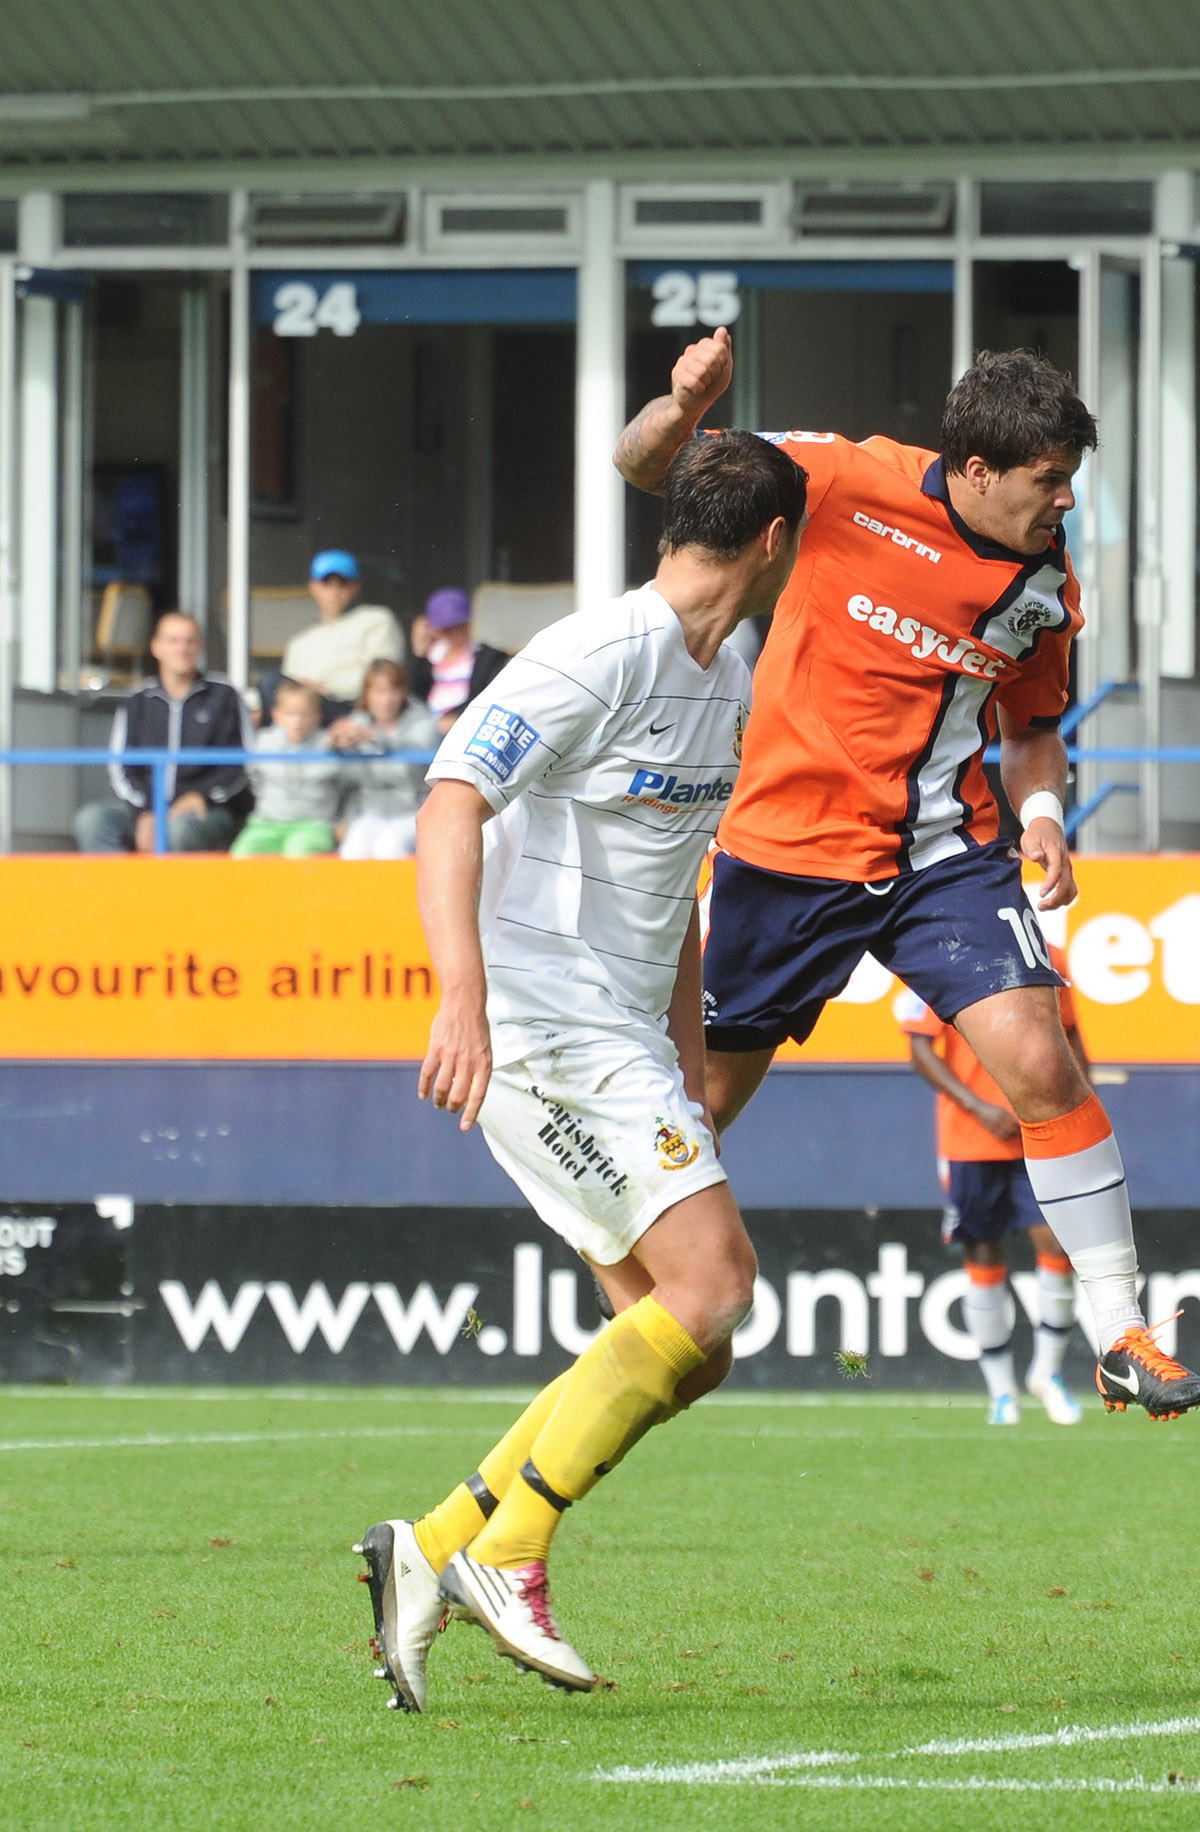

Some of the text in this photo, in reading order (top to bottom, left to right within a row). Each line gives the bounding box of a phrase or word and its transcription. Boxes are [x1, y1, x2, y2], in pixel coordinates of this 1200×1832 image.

[272, 281, 361, 337] 24
[651, 270, 740, 327] 25
[853, 511, 942, 564] carbrini
[847, 594, 1006, 678] easyJet
[475, 724, 511, 753] SQ
[485, 708, 537, 750] BLUE
[628, 768, 733, 804] Plante
[997, 906, 1053, 971] 10
[269, 953, 432, 997] airlin
[537, 1122, 588, 1181] Hotel
